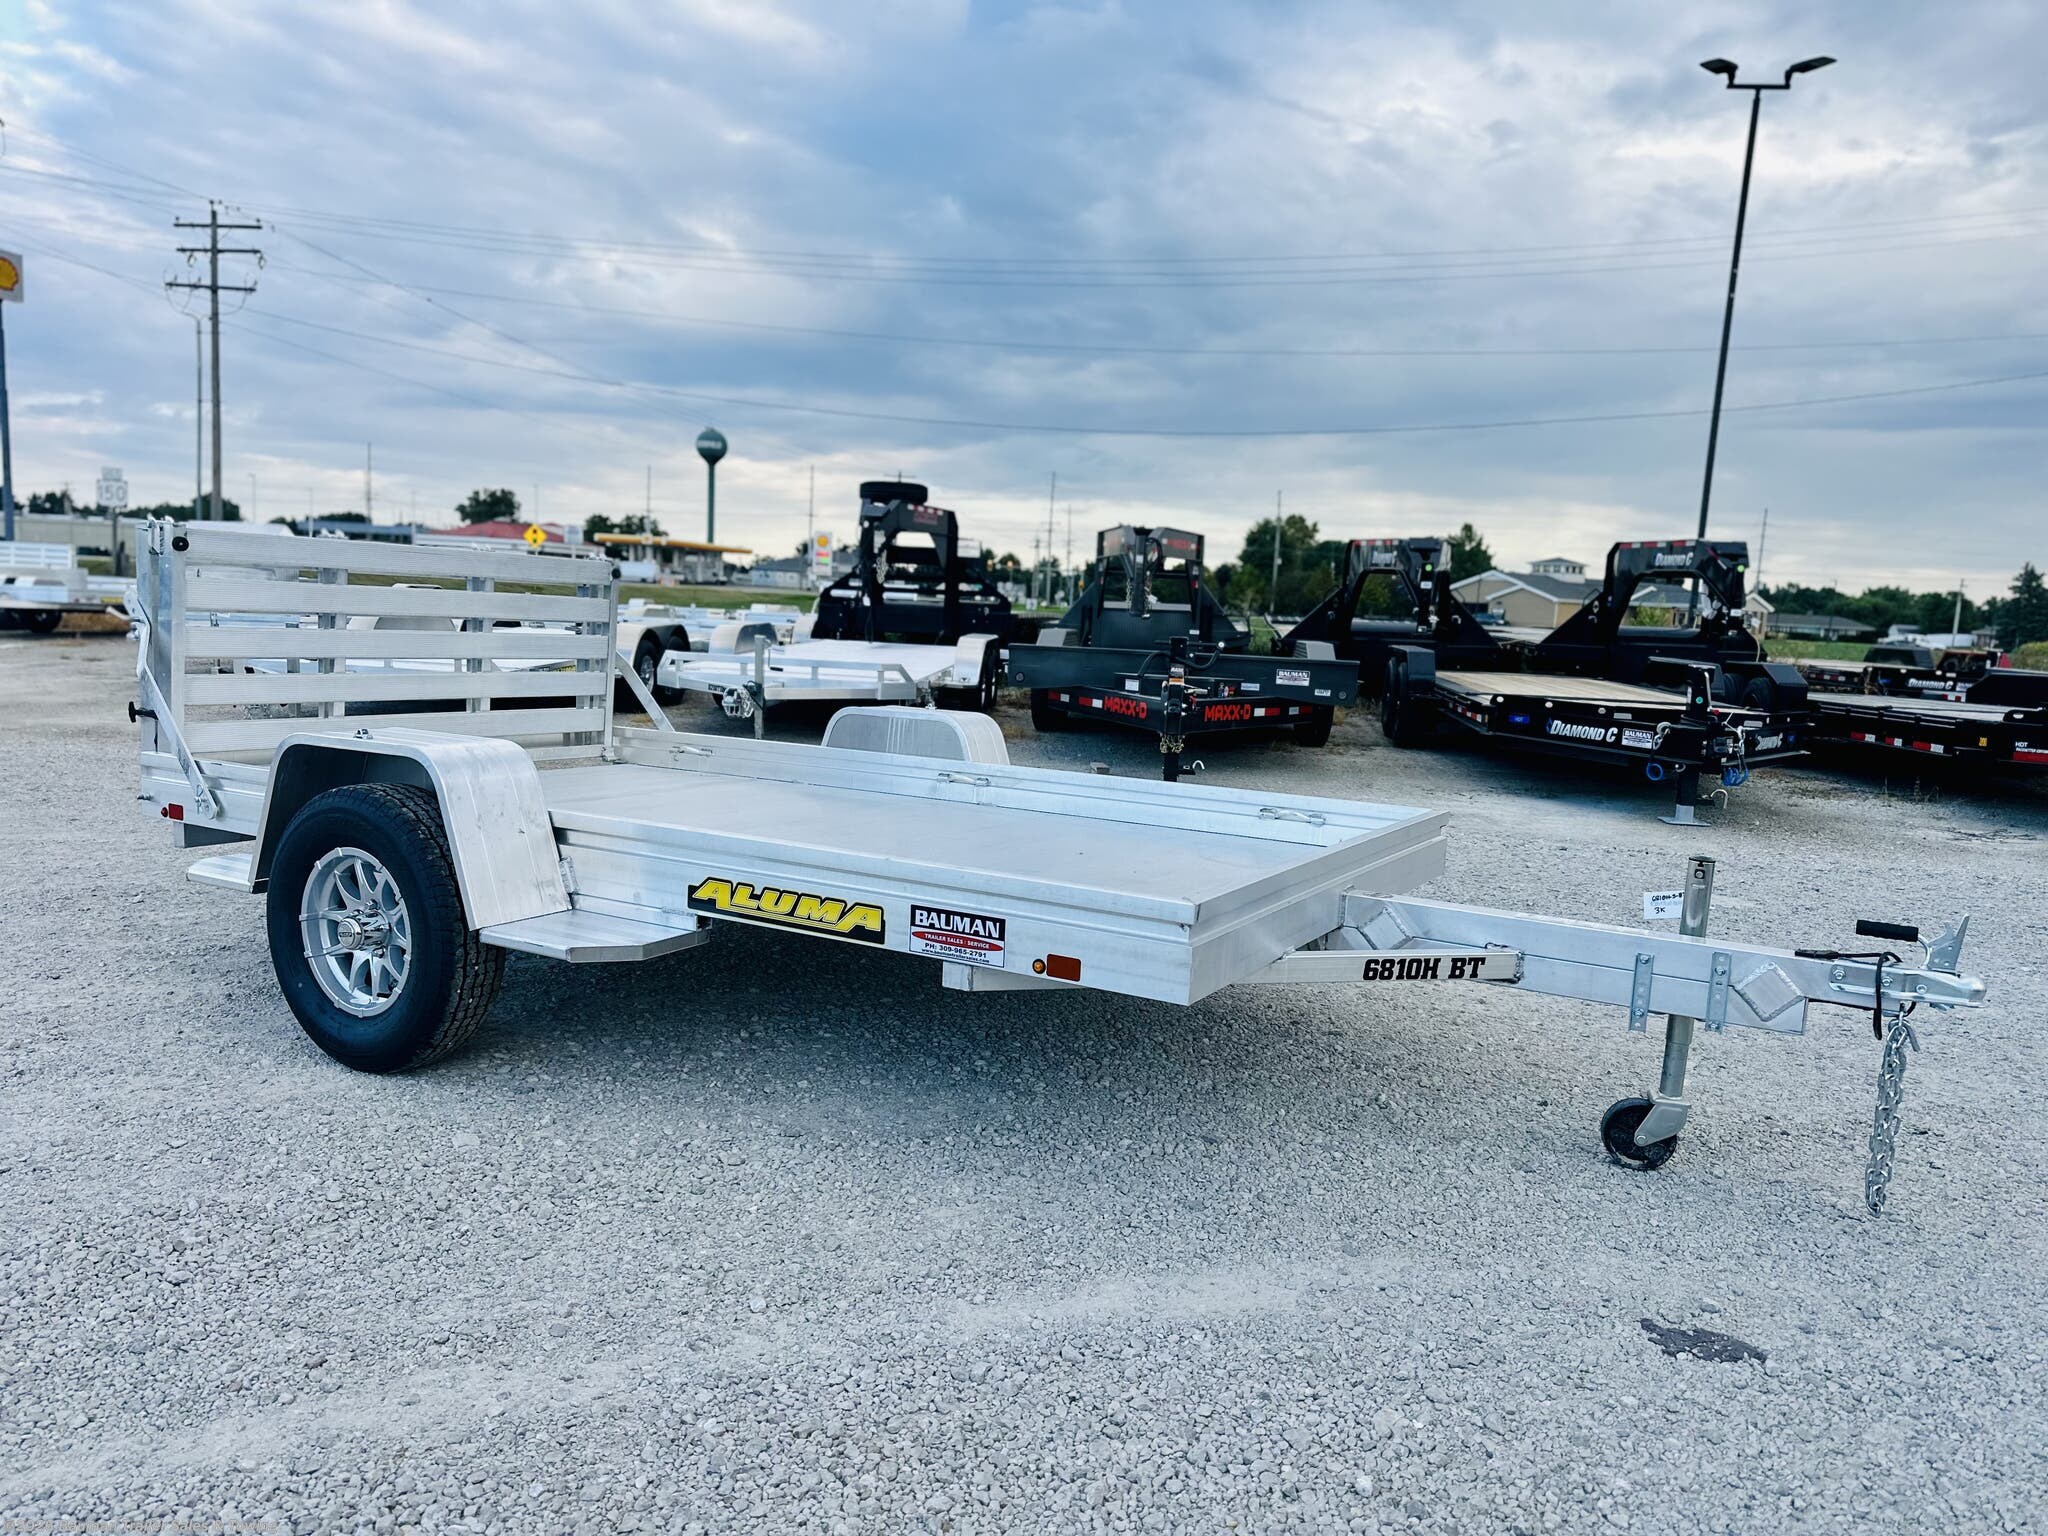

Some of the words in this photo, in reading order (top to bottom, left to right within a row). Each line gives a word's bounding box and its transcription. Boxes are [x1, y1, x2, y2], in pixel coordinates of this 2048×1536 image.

[97, 484, 128, 502] 150
[1655, 552, 1686, 567] DIAMOND
[1685, 552, 1694, 567] C
[1907, 678, 1945, 690] DIAMOND
[1945, 680, 1954, 690] C
[1549, 720, 1605, 741] DIAMOND
[1605, 727, 1618, 743] C
[691, 878, 882, 934] ALUMA
[914, 908, 1000, 939] BAUMAN
[924, 942, 938, 950] PH:
[925, 933, 946, 942] TRAILER
[946, 936, 964, 945] SALES
[967, 940, 990, 949] SERVICE
[1362, 957, 1441, 981] 6810H
[1447, 956, 1487, 980] BT
